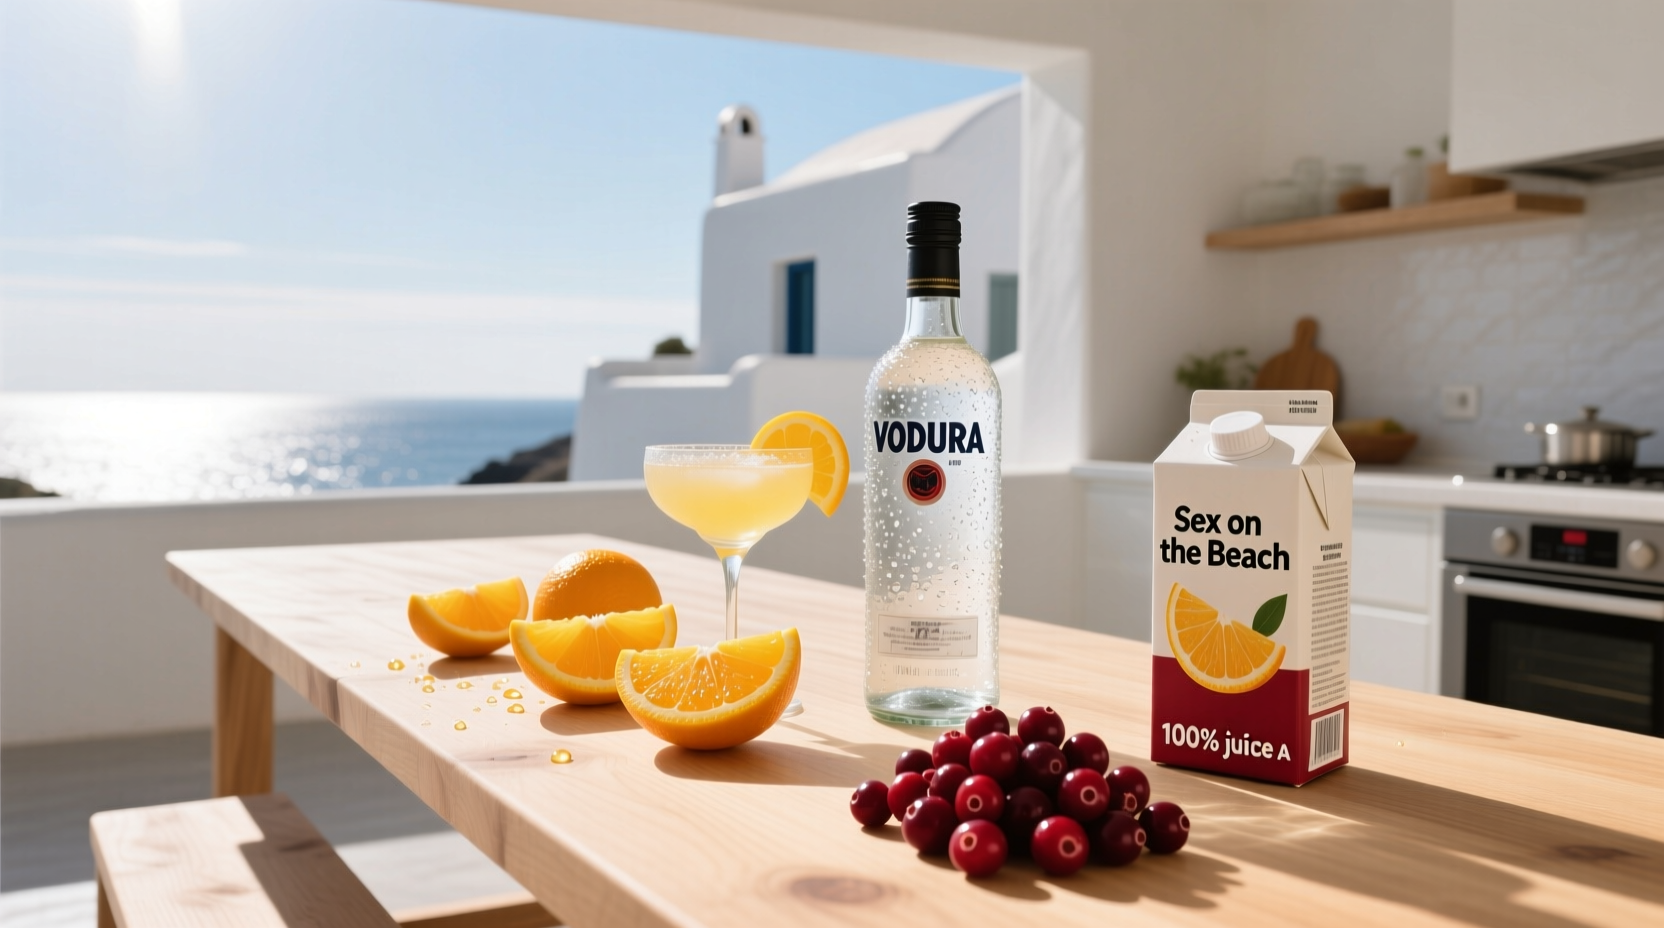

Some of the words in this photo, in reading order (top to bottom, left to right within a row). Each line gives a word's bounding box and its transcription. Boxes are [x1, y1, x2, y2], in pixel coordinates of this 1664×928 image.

[873, 420, 985, 454] VODURA
[1174, 505, 1221, 534] Sex
[1228, 514, 1261, 536] on
[1160, 536, 1201, 565] the
[1208, 539, 1290, 571] Beach
[1162, 722, 1220, 752] 100%
[1223, 730, 1274, 760] juice
[1277, 743, 1291, 761] A
